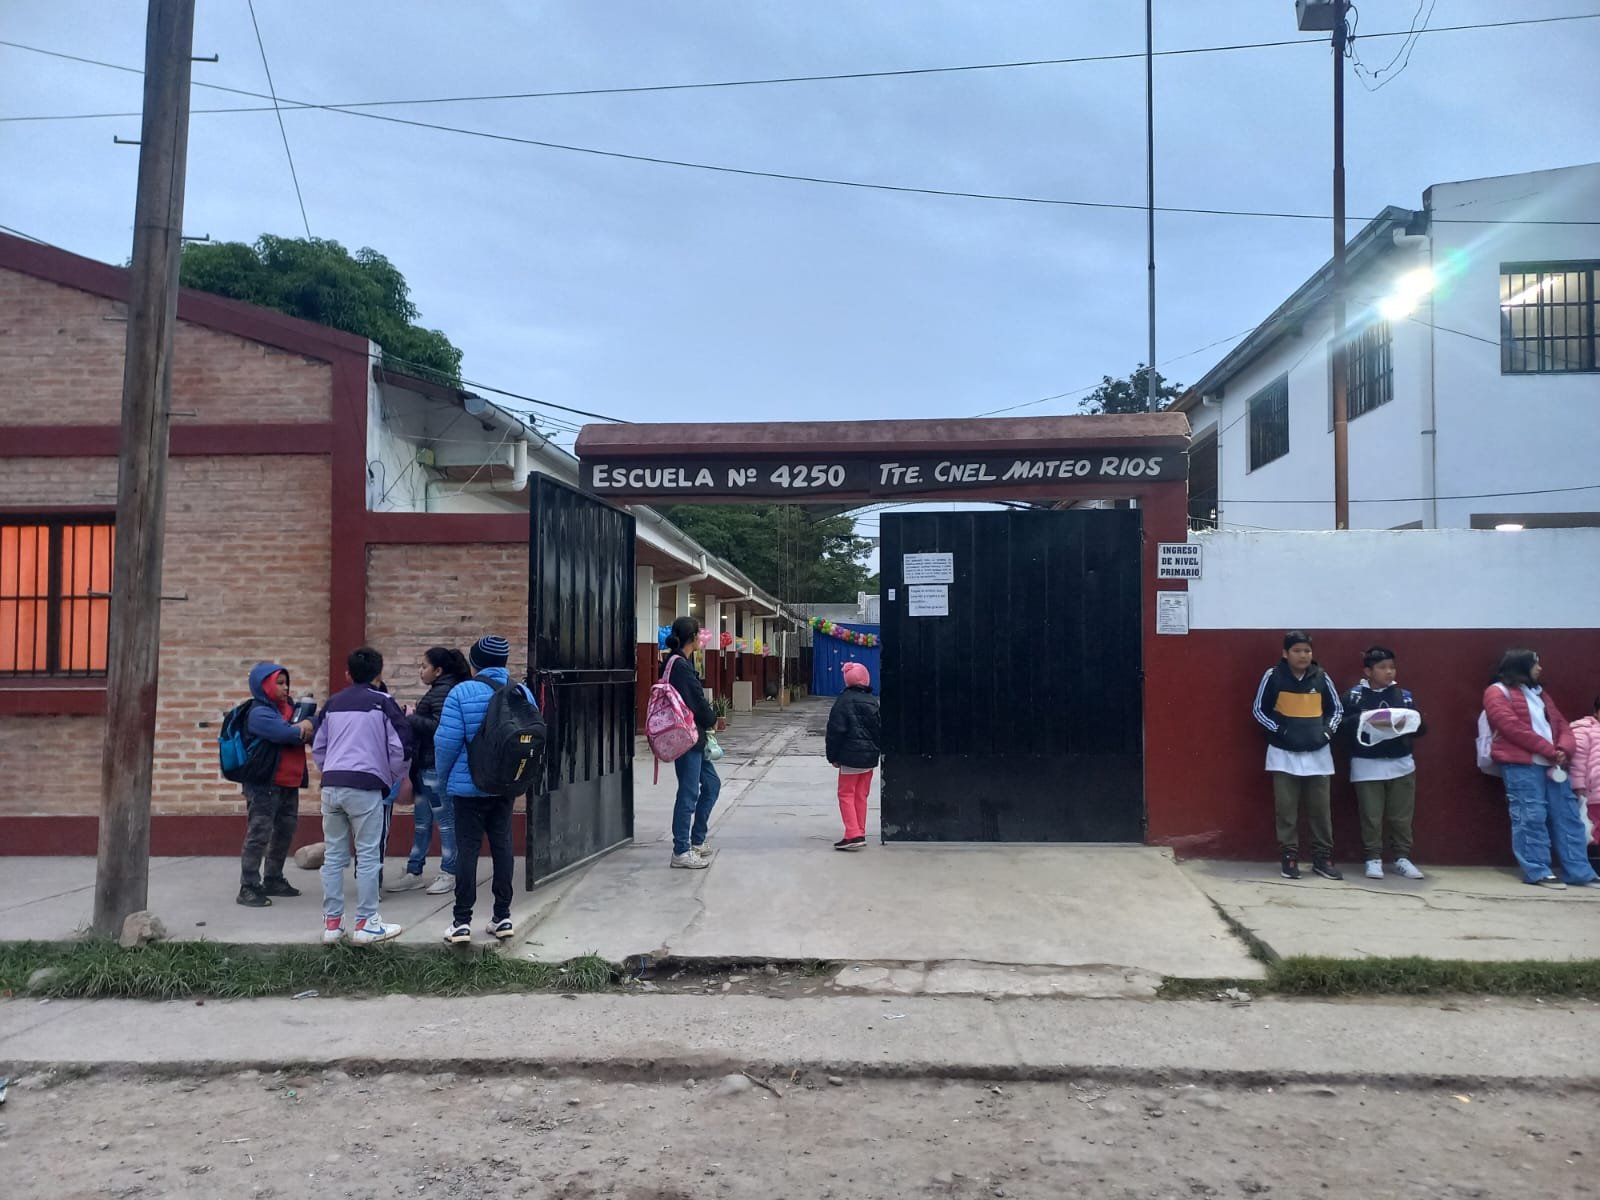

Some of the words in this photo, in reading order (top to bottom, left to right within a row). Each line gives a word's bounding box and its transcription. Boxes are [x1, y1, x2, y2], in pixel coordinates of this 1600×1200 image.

[592, 464, 714, 488] ESCUELA
[770, 464, 846, 488] 4250
[879, 462, 923, 485] TTE.
[934, 461, 997, 483] CNEL
[1002, 459, 1091, 481] MATEO
[1099, 456, 1163, 477] RIOS
[1162, 546, 1198, 555] INGRESO
[1161, 557, 1173, 566] DE
[1175, 557, 1199, 566] NIVEL
[1160, 568, 1200, 577] PRIMARIO
